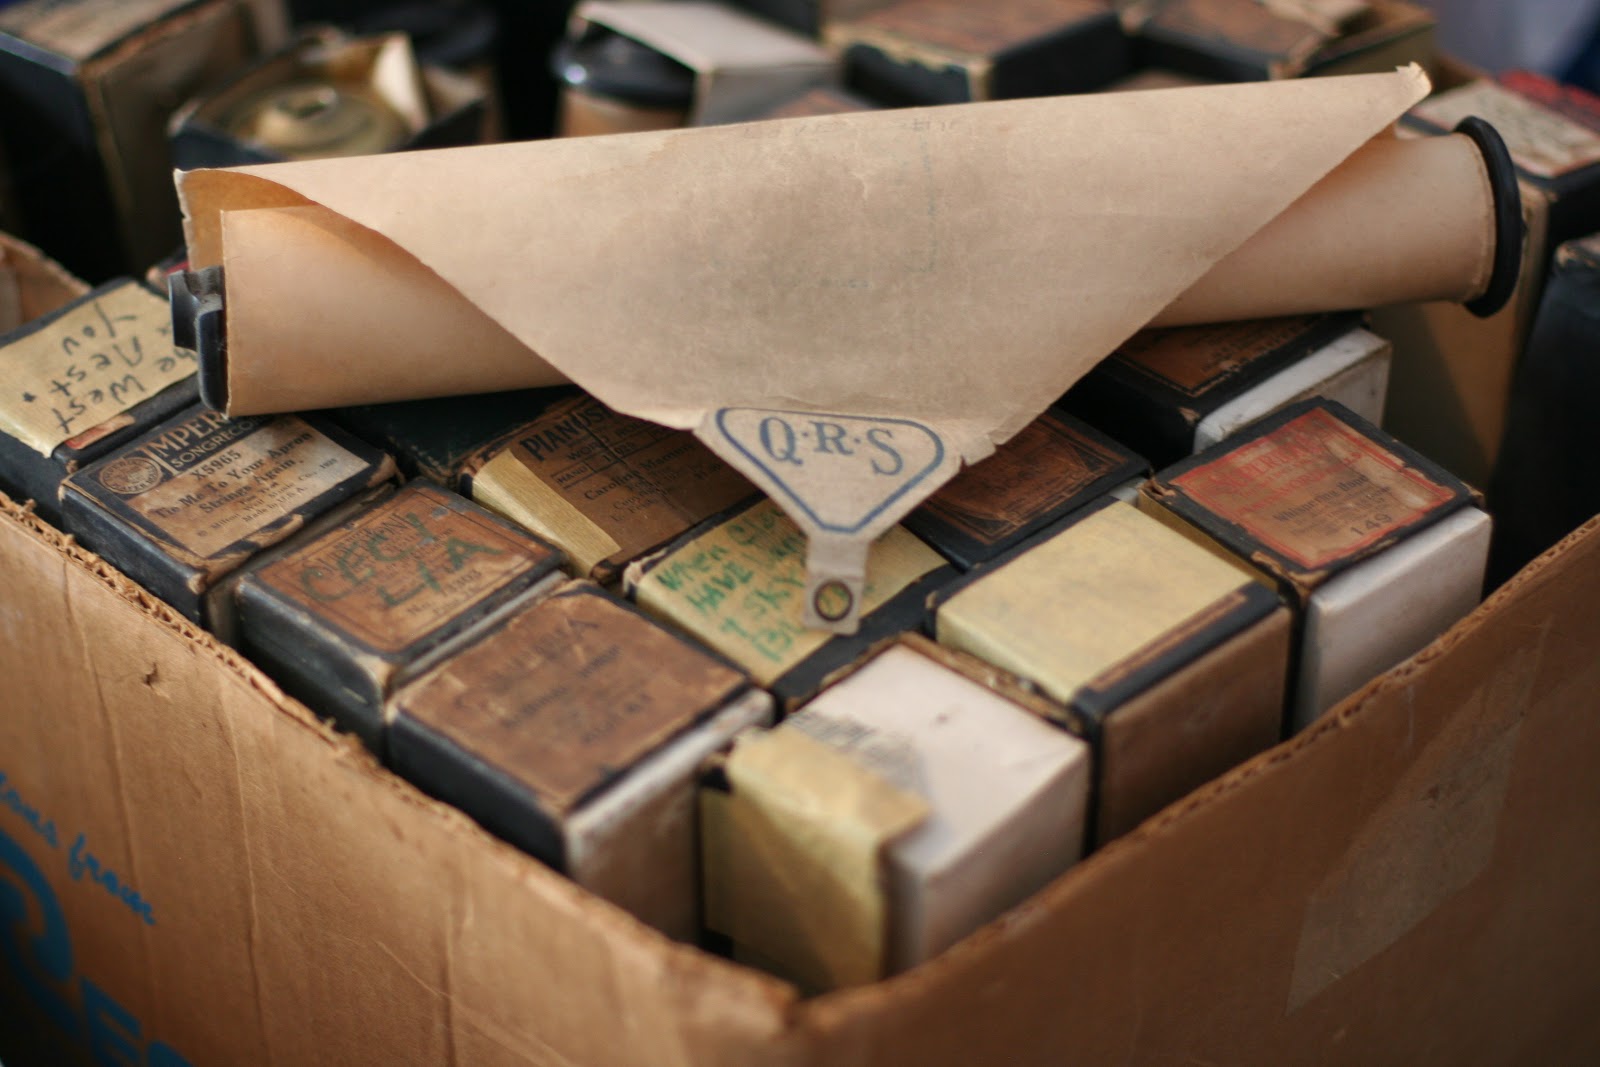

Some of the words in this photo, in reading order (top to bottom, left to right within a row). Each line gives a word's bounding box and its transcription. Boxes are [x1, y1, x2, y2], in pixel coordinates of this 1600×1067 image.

[138, 408, 228, 476] IMPER
[192, 450, 242, 481] X5965
[227, 458, 262, 480] Your
[200, 485, 253, 514] Strings
[1350, 514, 1394, 535] 149
